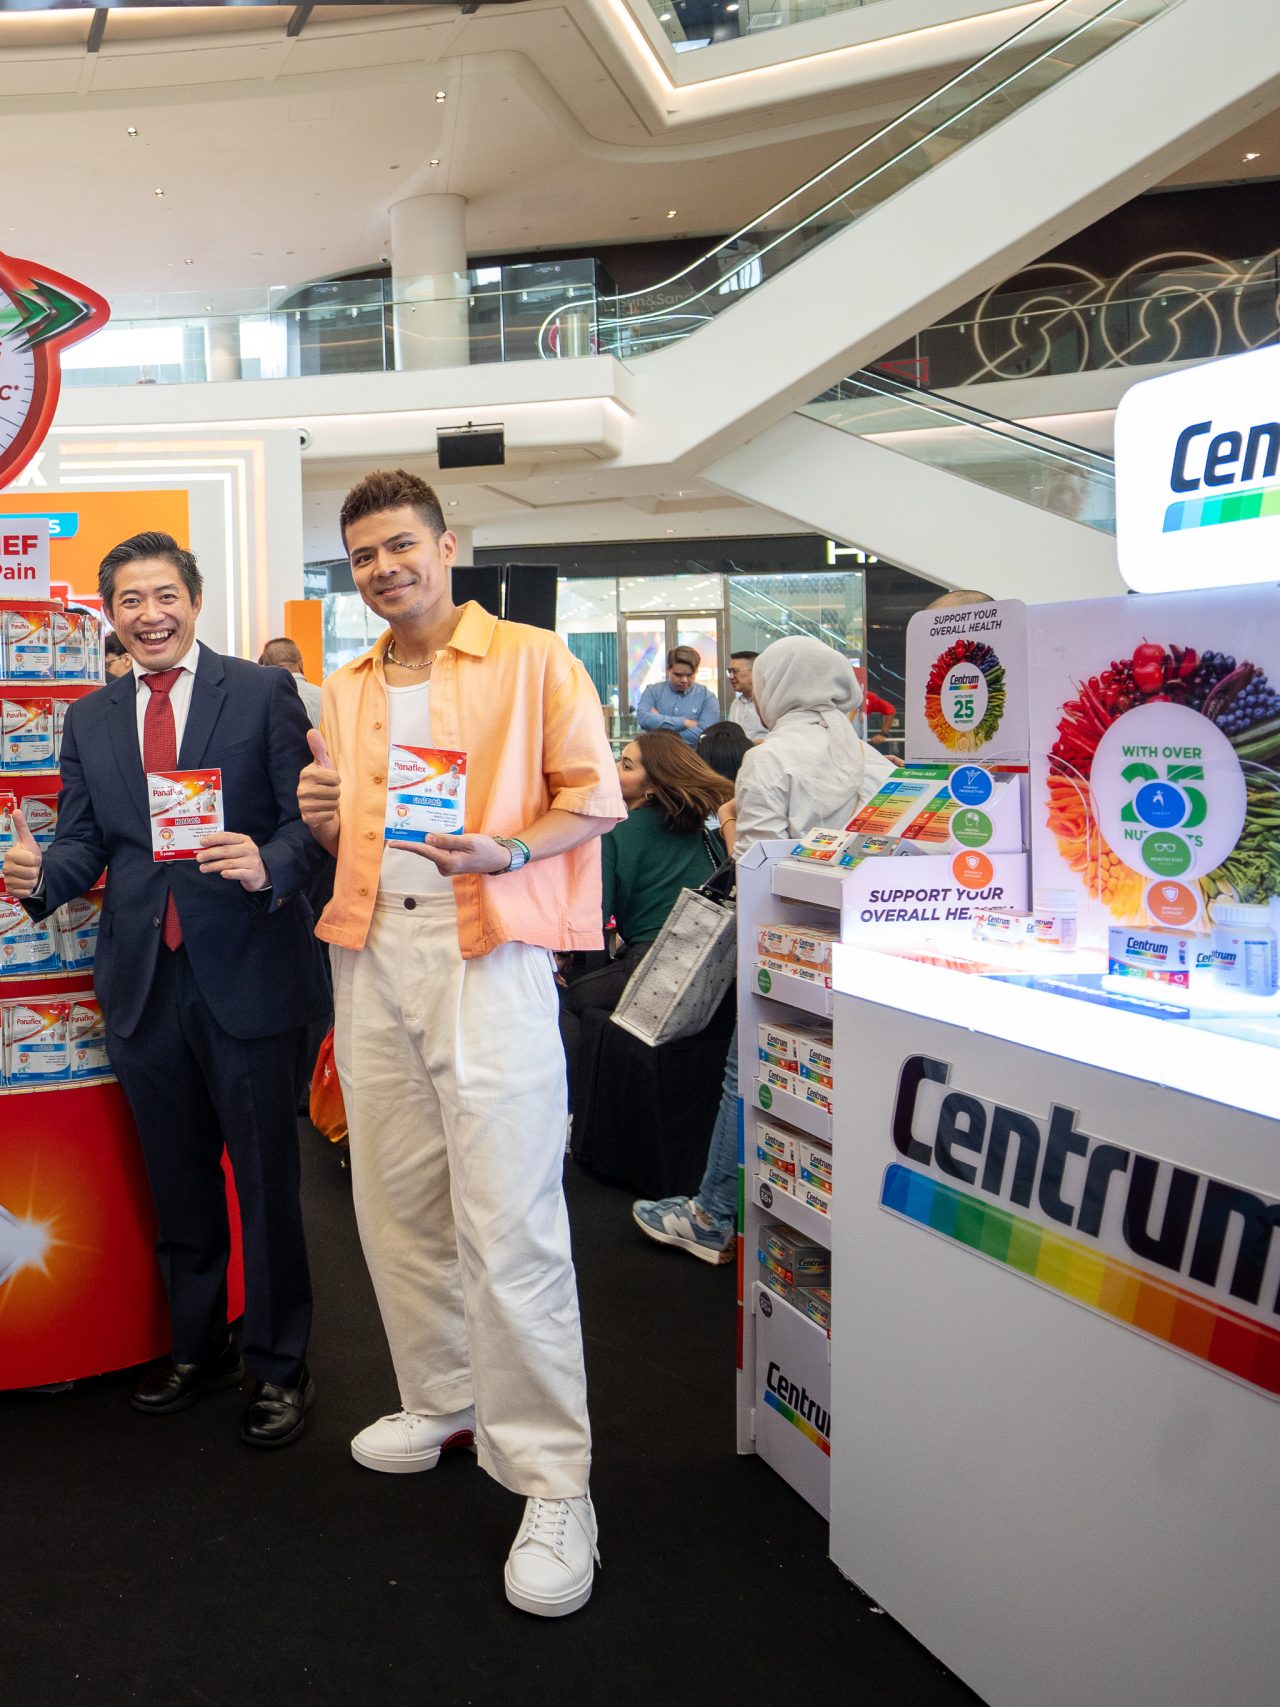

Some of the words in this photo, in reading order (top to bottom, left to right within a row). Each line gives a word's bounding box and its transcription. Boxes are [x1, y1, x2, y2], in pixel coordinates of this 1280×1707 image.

[934, 611, 971, 625] SUPPORT
[973, 608, 998, 620] YOUR
[929, 624, 966, 637] OVERALL
[968, 619, 1003, 633] HEALTH
[950, 674, 980, 685] Centrum
[953, 699, 975, 719] 25
[1122, 745, 1158, 758] WITH
[1162, 746, 1202, 759] OVER
[815, 832, 839, 842] Centrum
[864, 836, 889, 847] Centrum
[868, 888, 951, 903] SUPPORT
[956, 887, 1004, 901] YOUR
[860, 908, 941, 923] OVERALL
[987, 914, 1011, 926] Centrum
[1127, 937, 1169, 955] Centrum
[767, 1033, 788, 1048] Centrum
[809, 1049, 832, 1064] Centrum
[768, 1069, 788, 1084] Centrum
[807, 1087, 829, 1103] Centrum
[810, 1153, 832, 1171] Centrum
[893, 1055, 1280, 1315] Centrum
[806, 1191, 828, 1210] Centrum
